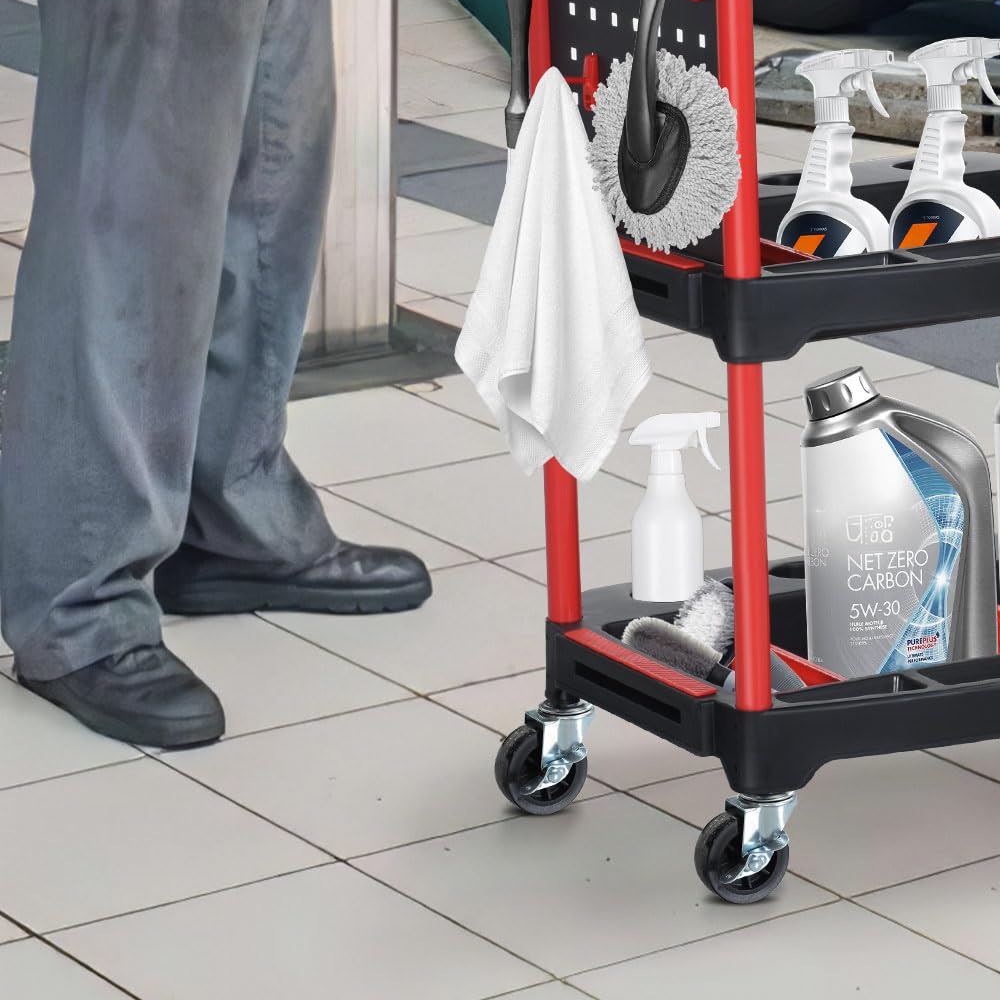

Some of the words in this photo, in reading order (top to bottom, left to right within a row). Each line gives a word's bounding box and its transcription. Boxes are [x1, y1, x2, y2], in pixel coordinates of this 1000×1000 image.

[847, 552, 884, 572] NET
[887, 549, 929, 569] ZERO
[847, 568, 923, 592] CARBON
[849, 600, 900, 619] 5W-30
[906, 635, 937, 646] PUREPLUS
